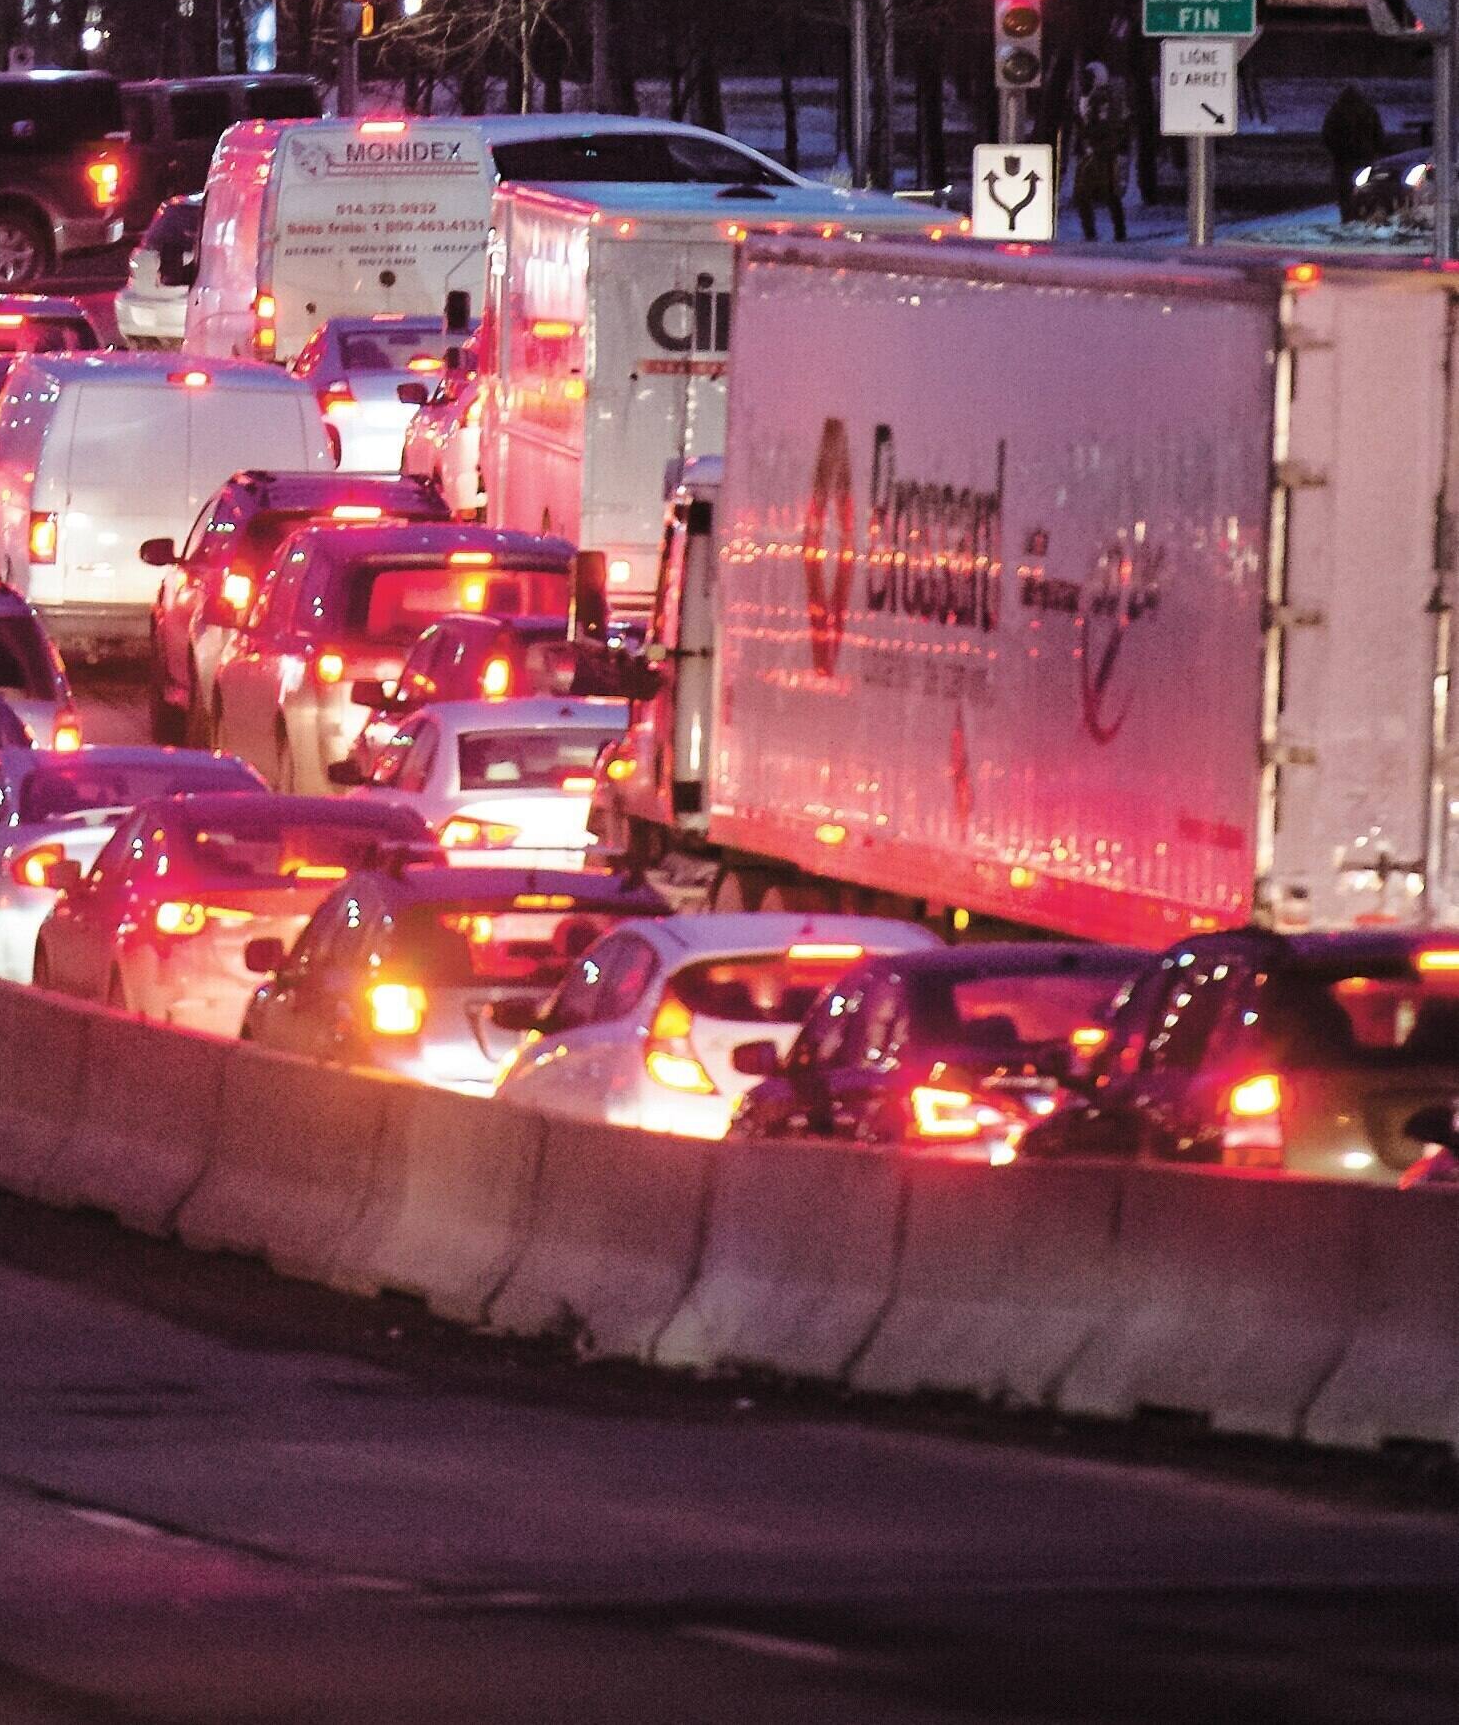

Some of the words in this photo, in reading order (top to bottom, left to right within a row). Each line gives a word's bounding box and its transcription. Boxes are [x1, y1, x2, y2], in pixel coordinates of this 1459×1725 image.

[1178, 7, 1220, 29] FIN
[1179, 49, 1219, 65] LIGNE
[346, 142, 462, 162] MONIDEX
